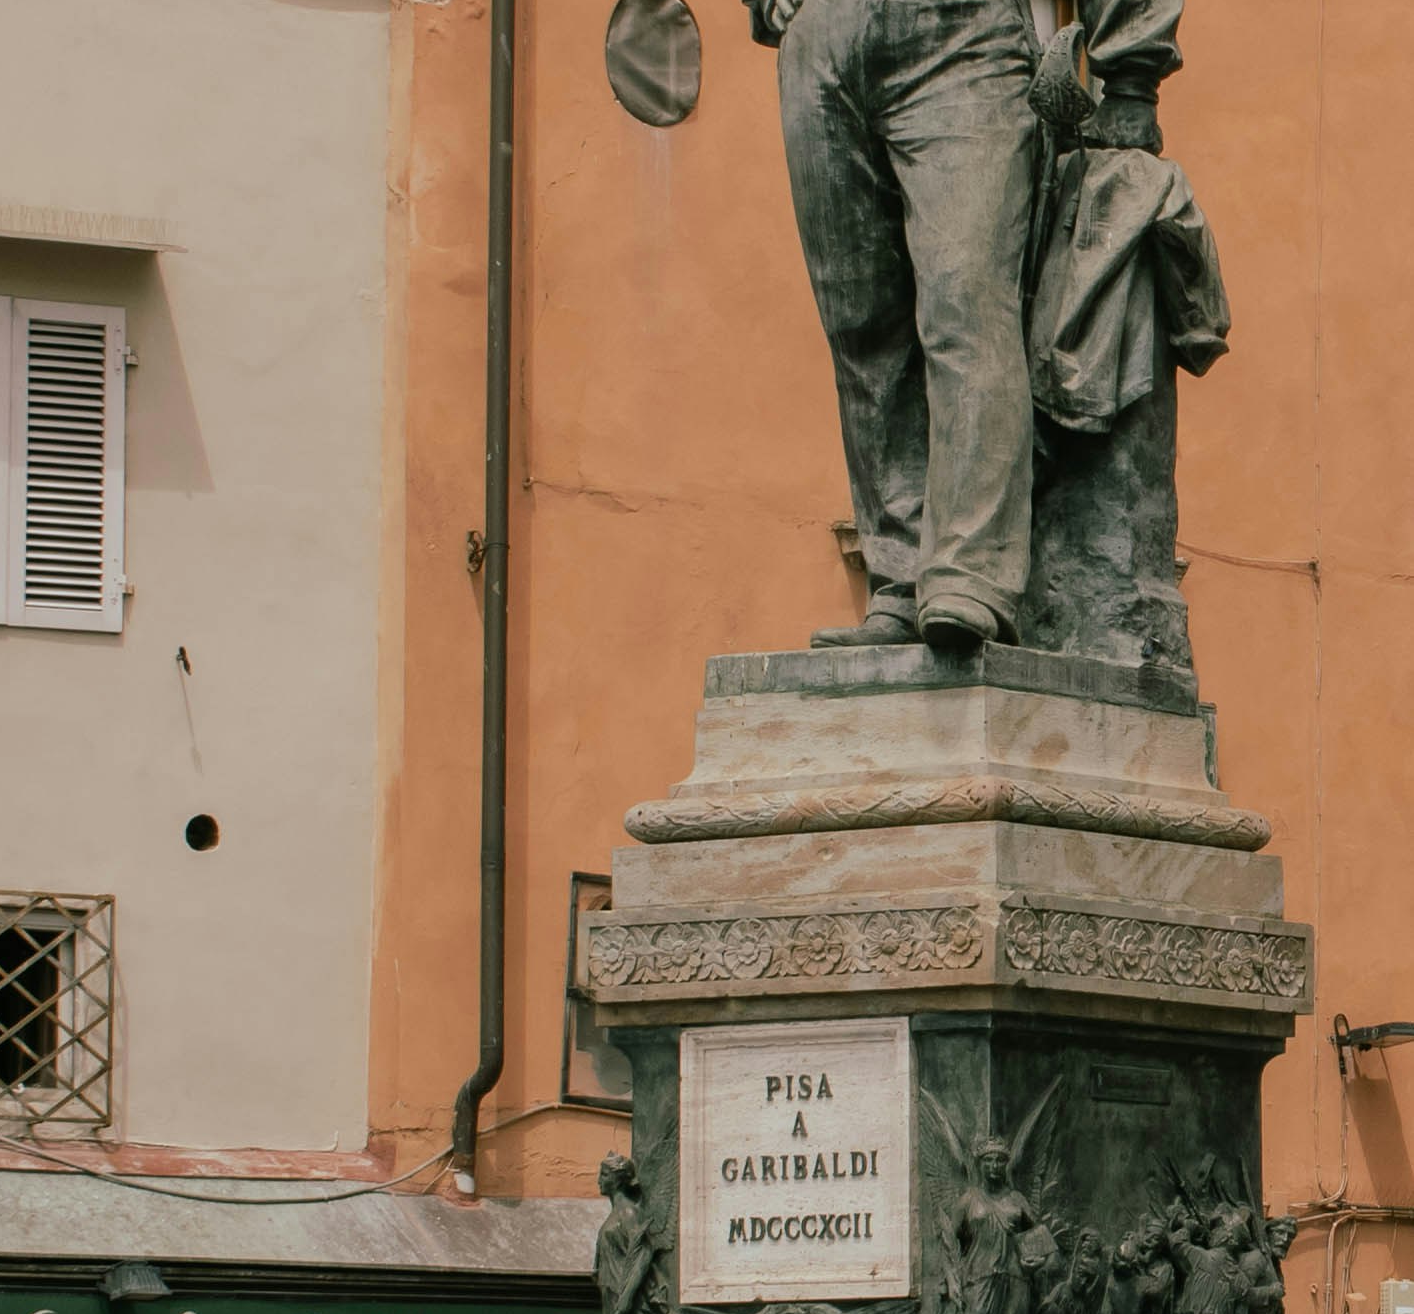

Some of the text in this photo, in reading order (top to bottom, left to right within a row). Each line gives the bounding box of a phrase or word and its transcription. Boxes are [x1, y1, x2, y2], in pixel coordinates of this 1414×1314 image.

[765, 1073, 833, 1101] PISA
[791, 1111, 808, 1137] A
[721, 1150, 878, 1182] GARIBALDI
[728, 1213, 873, 1243] MDCCCXCII
